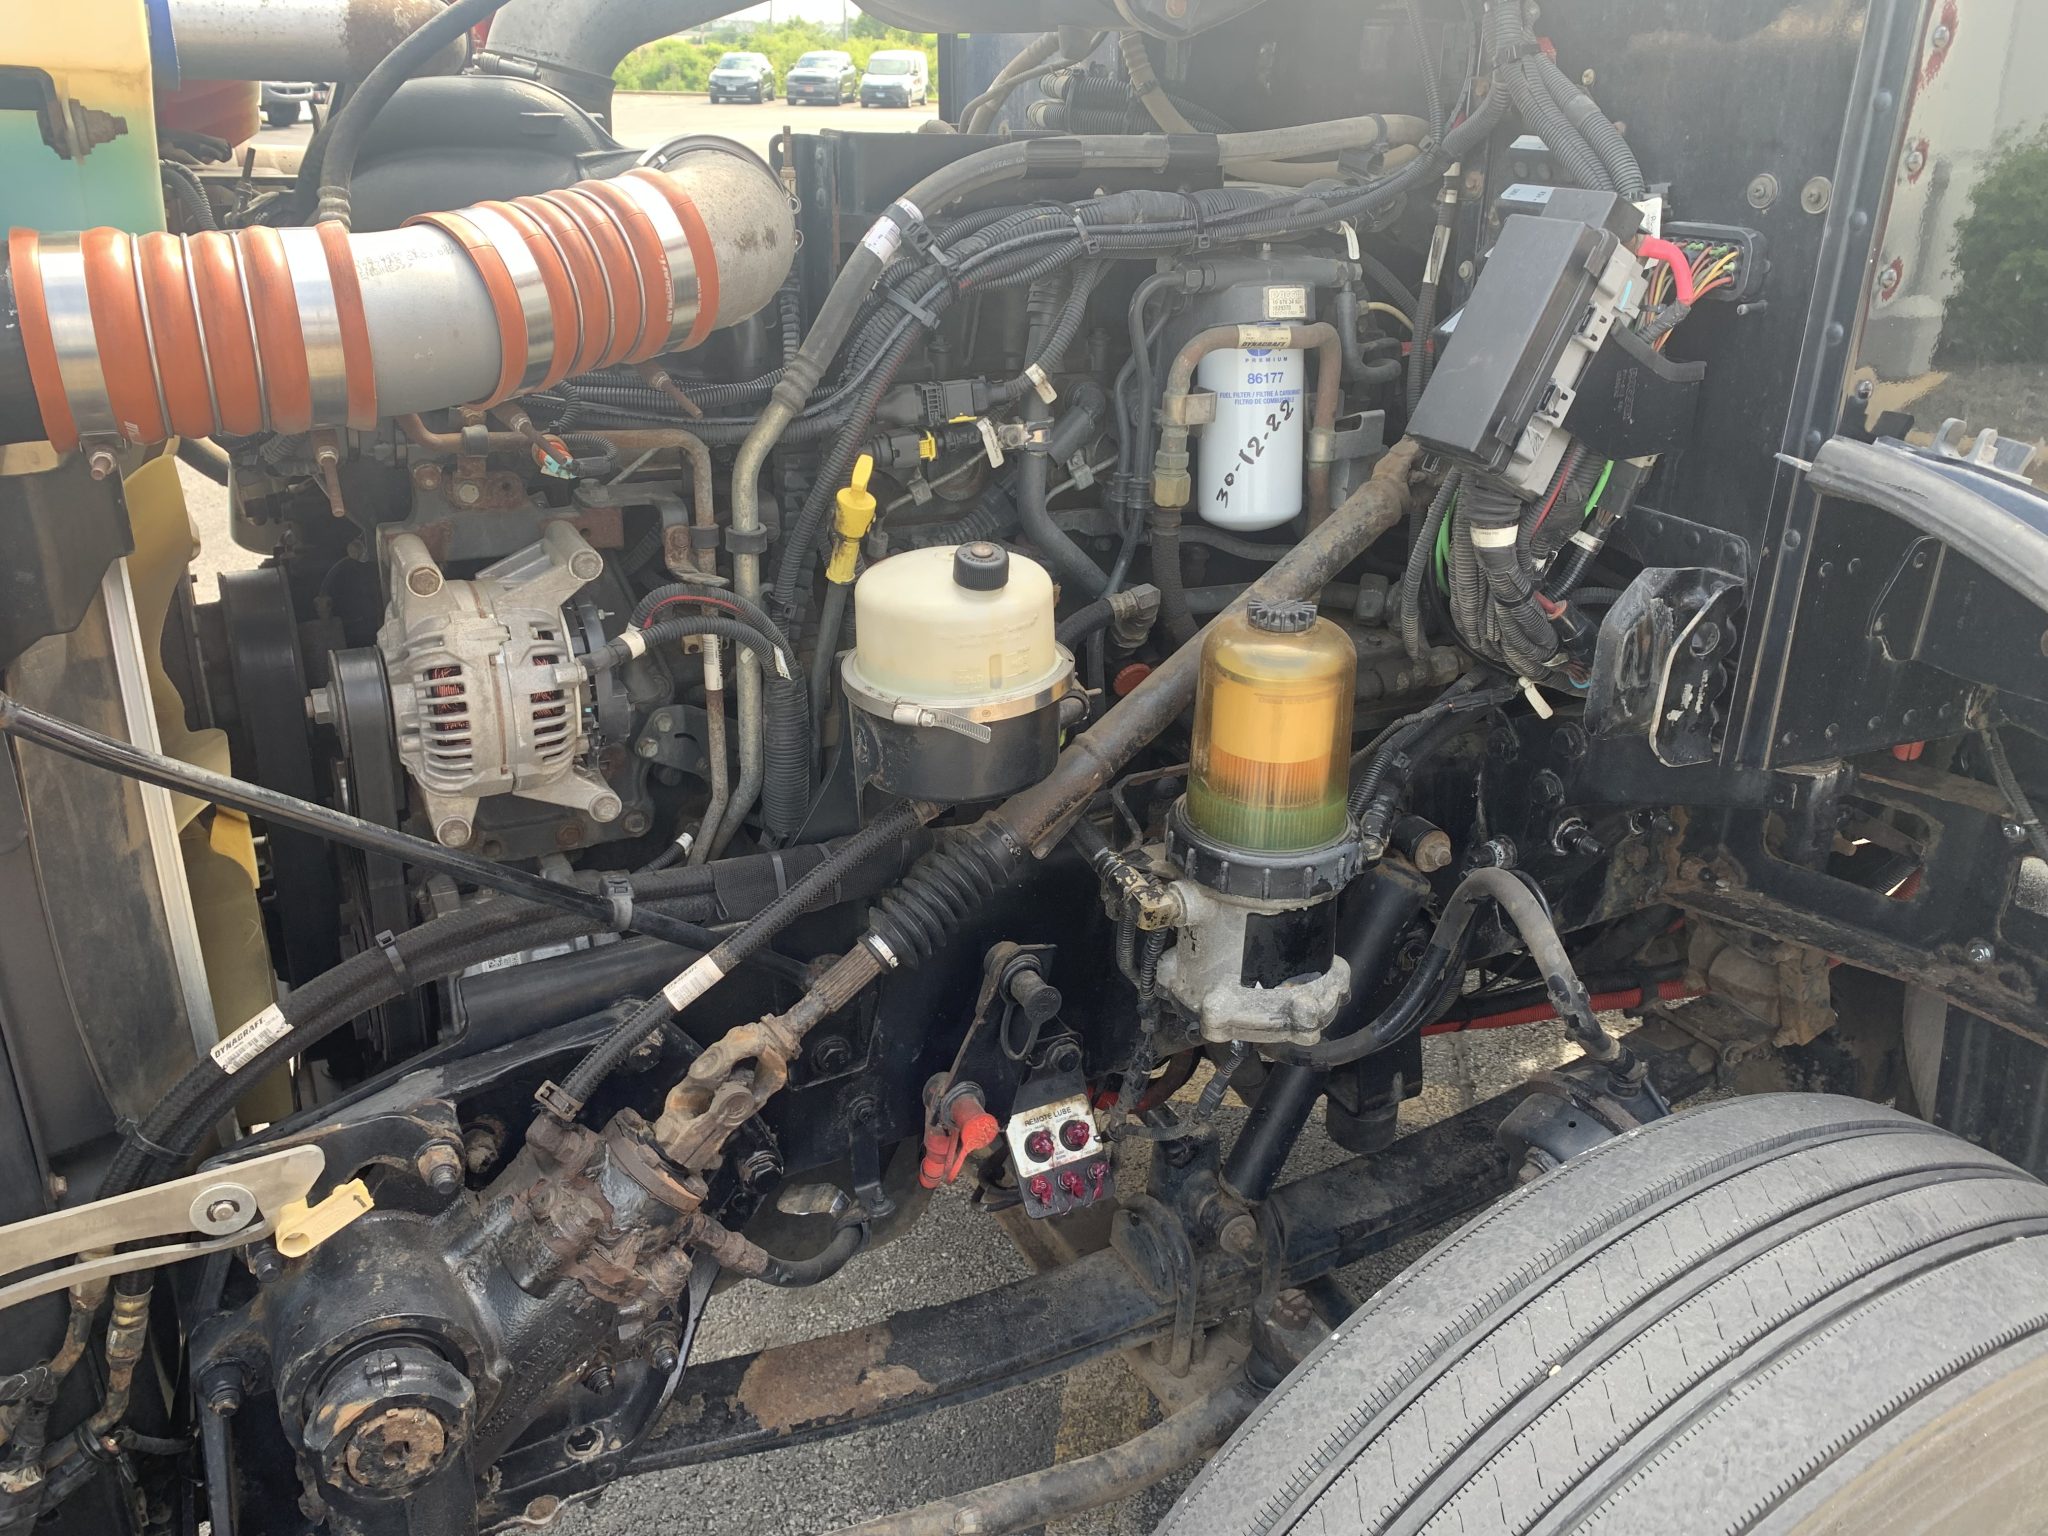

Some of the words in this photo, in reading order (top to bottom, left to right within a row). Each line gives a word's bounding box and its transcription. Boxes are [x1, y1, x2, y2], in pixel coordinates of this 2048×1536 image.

[1247, 372, 1284, 384] 86177
[214, 1016, 264, 1059] DYNACRAFT
[1024, 1112, 1053, 1127] REMOTE
[1053, 1107, 1072, 1118] LUBE
